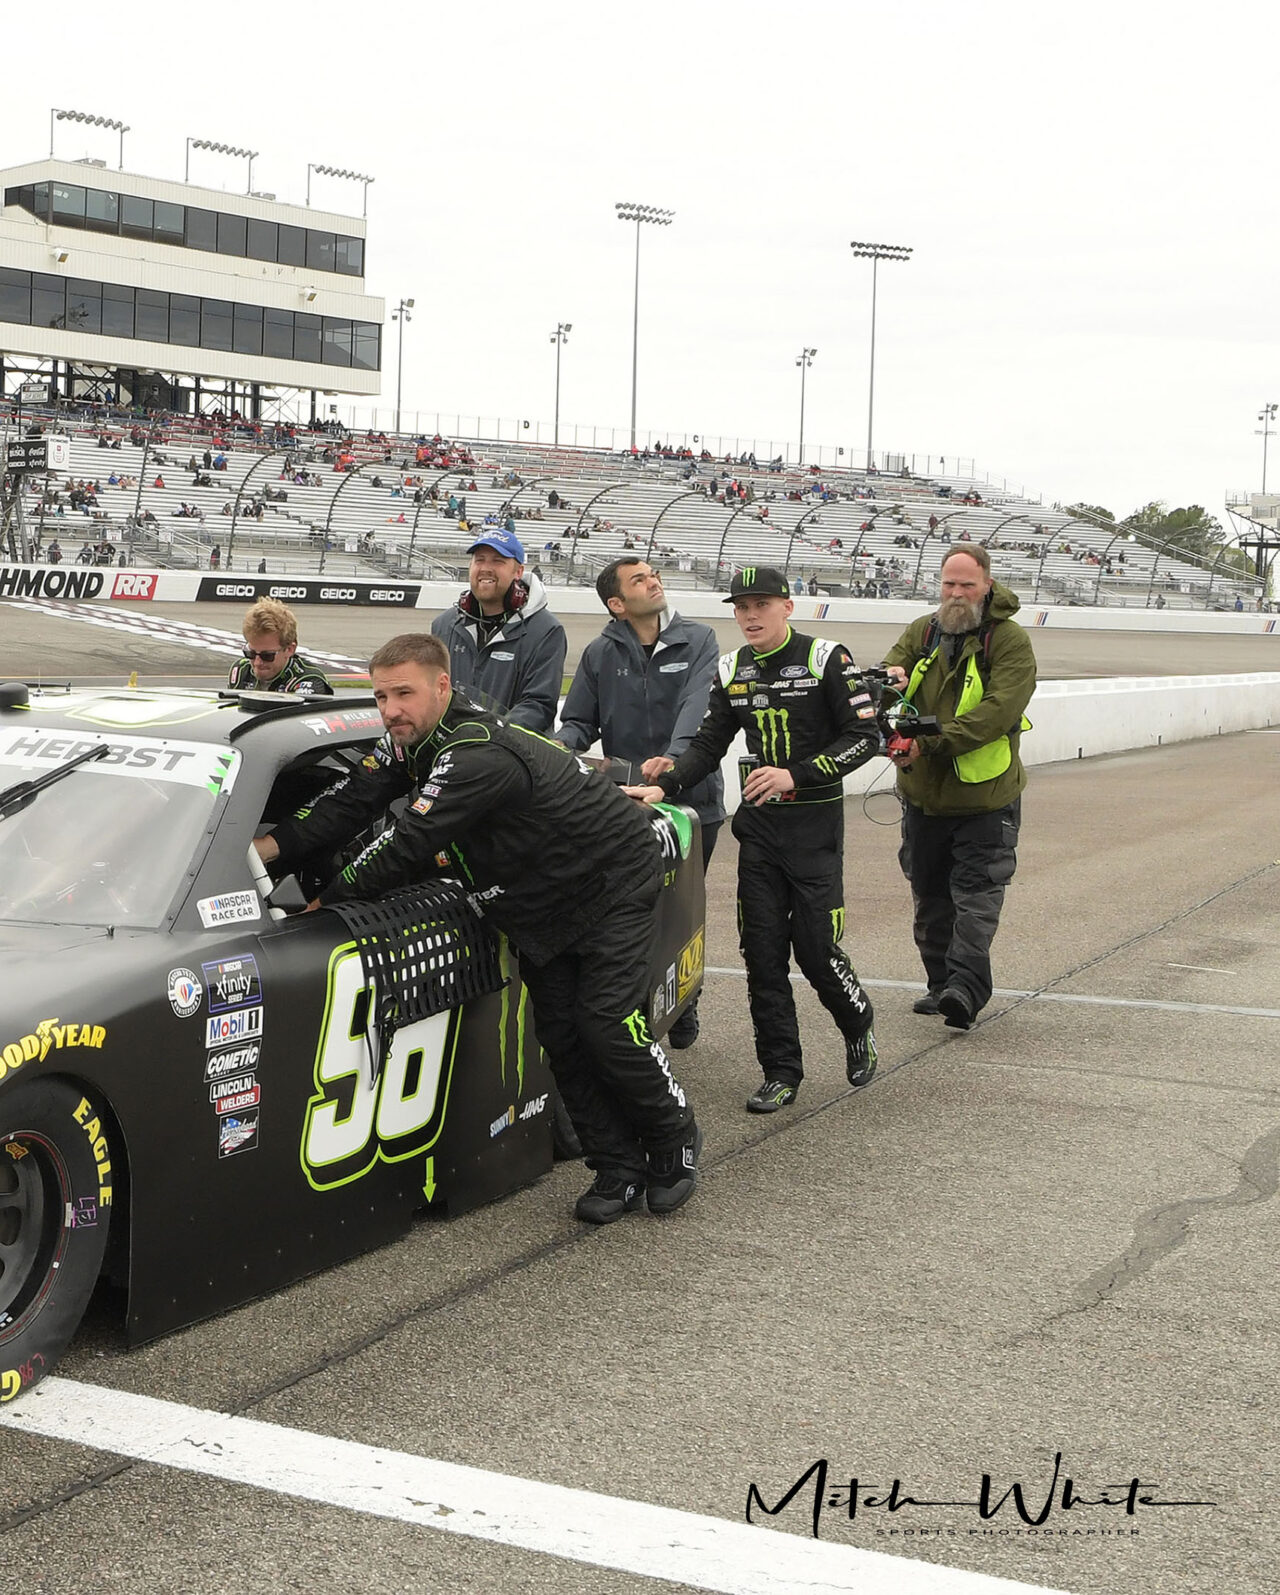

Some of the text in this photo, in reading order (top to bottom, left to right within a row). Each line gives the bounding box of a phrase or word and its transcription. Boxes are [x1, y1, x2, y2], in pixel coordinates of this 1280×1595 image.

[329, 404, 337, 413] E
[523, 420, 530, 429] D
[693, 434, 699, 443] C
[838, 447, 844, 456] B
[940, 456, 945, 464] A
[477, 530, 509, 543] Ford
[114, 574, 155, 598] RR
[216, 584, 256, 597] GEICO
[269, 586, 308, 598] GEICO
[319, 588, 357, 600] GEICO
[370, 589, 405, 601] GEICO
[782, 666, 808, 677] Ford
[343, 711, 373, 721] RILEY
[6, 736, 196, 771] HERBST
[218, 894, 252, 909] NASCAR
[211, 907, 254, 921] RACE CAR
[216, 972, 251, 1000] xfinity
[210, 1011, 256, 1040] Mobil 1
[207, 1045, 259, 1074] COMETIC
[213, 1077, 252, 1099] LINCOLN
[220, 1092, 255, 1110] WELDERS
[72, 1097, 112, 1207] EAGLE
